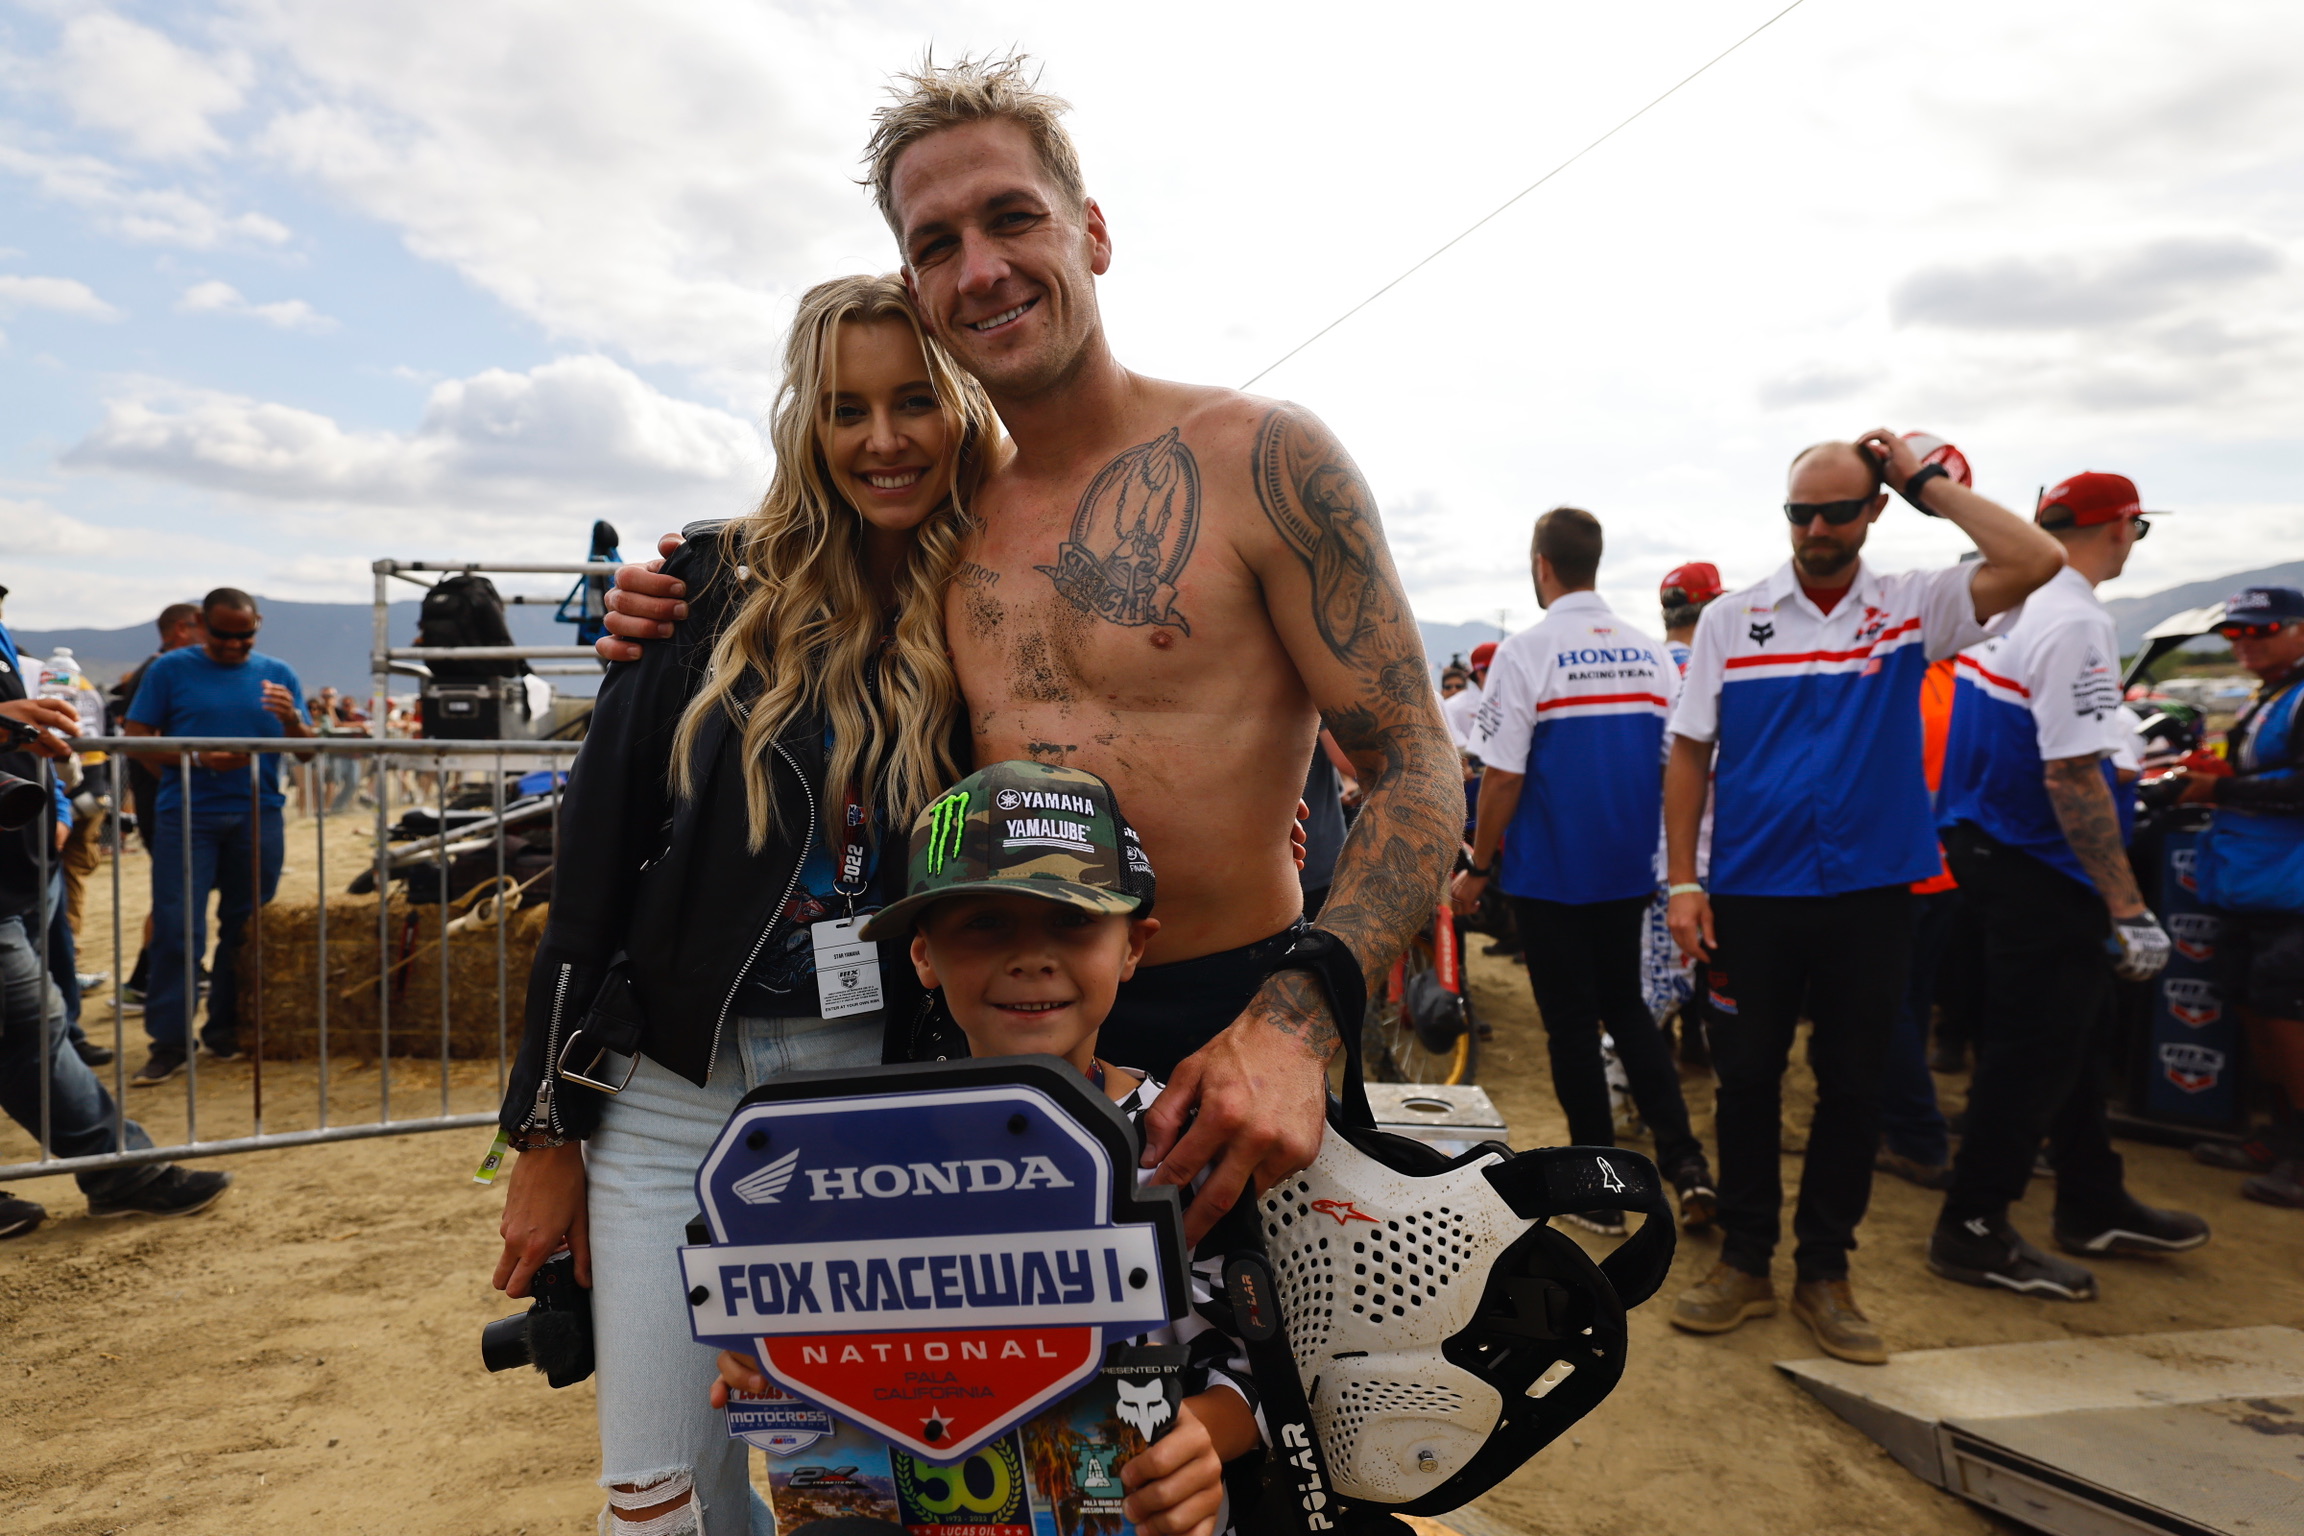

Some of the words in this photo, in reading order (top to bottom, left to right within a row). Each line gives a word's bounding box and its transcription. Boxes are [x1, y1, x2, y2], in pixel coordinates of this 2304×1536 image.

[1557, 648, 1659, 668] HONDA
[1568, 670, 1616, 681] RACING
[1020, 791, 1095, 817] YAMAHA
[842, 844, 864, 884] 2022
[833, 952, 844, 960] STAR
[805, 1156, 1074, 1201] HONDA
[718, 1261, 823, 1317] FOX
[825, 1249, 1096, 1313] RACEWAY
[1241, 1274, 1266, 1328] POLAR
[802, 1339, 1058, 1364] NATIONAL
[904, 1371, 959, 1385] PALA
[1100, 1366, 1161, 1375] RESENTED
[1164, 1365, 1179, 1373] BY
[873, 1385, 995, 1400] CALIFORNIA
[730, 1411, 827, 1423] MOTOCROSS
[913, 1446, 1011, 1514] 50
[1281, 1422, 1335, 1531] POLAR
[940, 1526, 976, 1536] LUCAS
[978, 1526, 997, 1536] OIL
